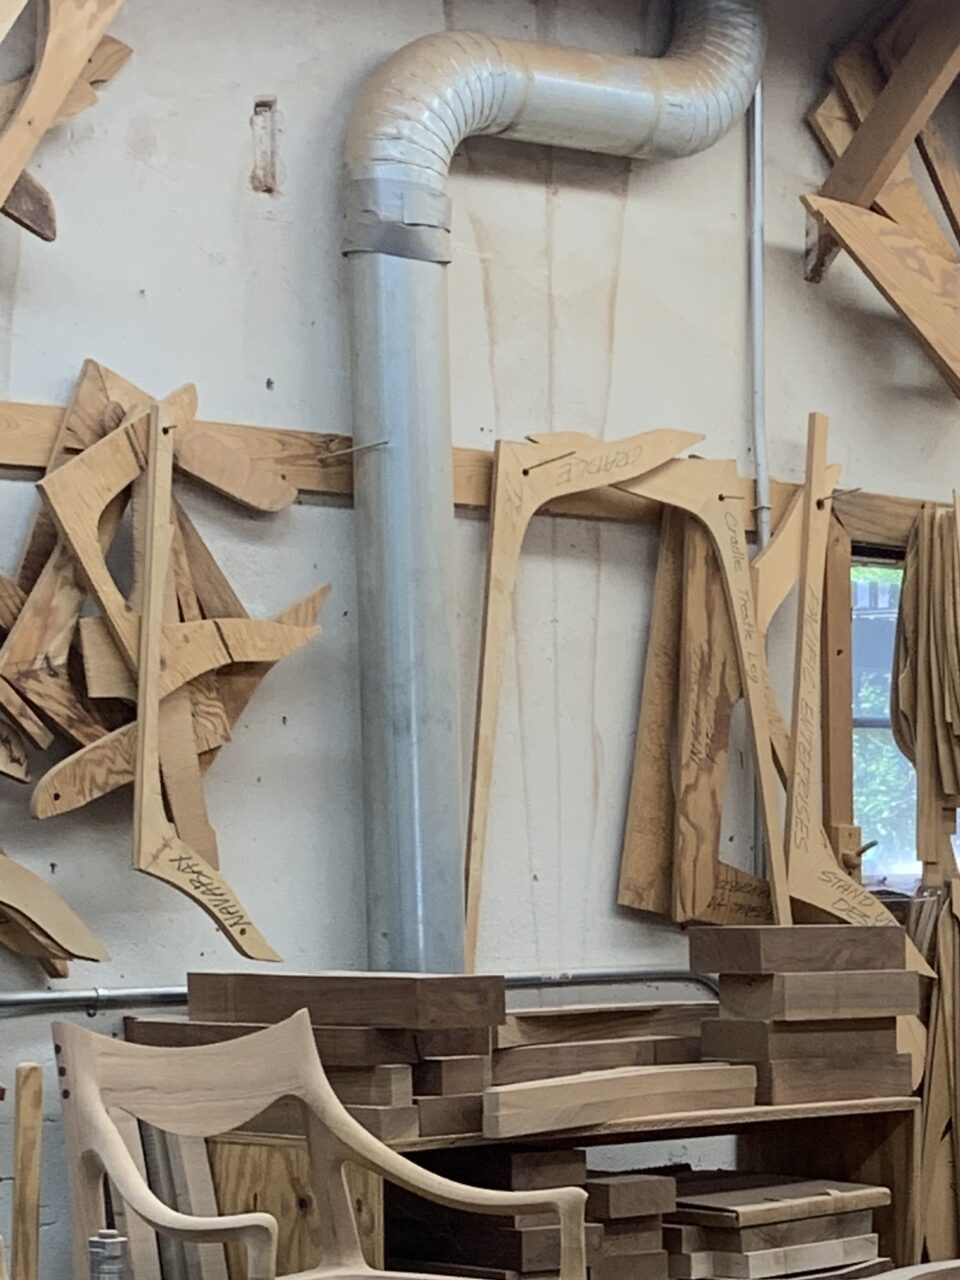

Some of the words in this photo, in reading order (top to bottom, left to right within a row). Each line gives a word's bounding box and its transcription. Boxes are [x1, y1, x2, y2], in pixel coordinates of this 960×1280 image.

[723, 510, 745, 572] Cradle
[818, 869, 876, 907] STAND
[832, 897, 876, 926] DES
